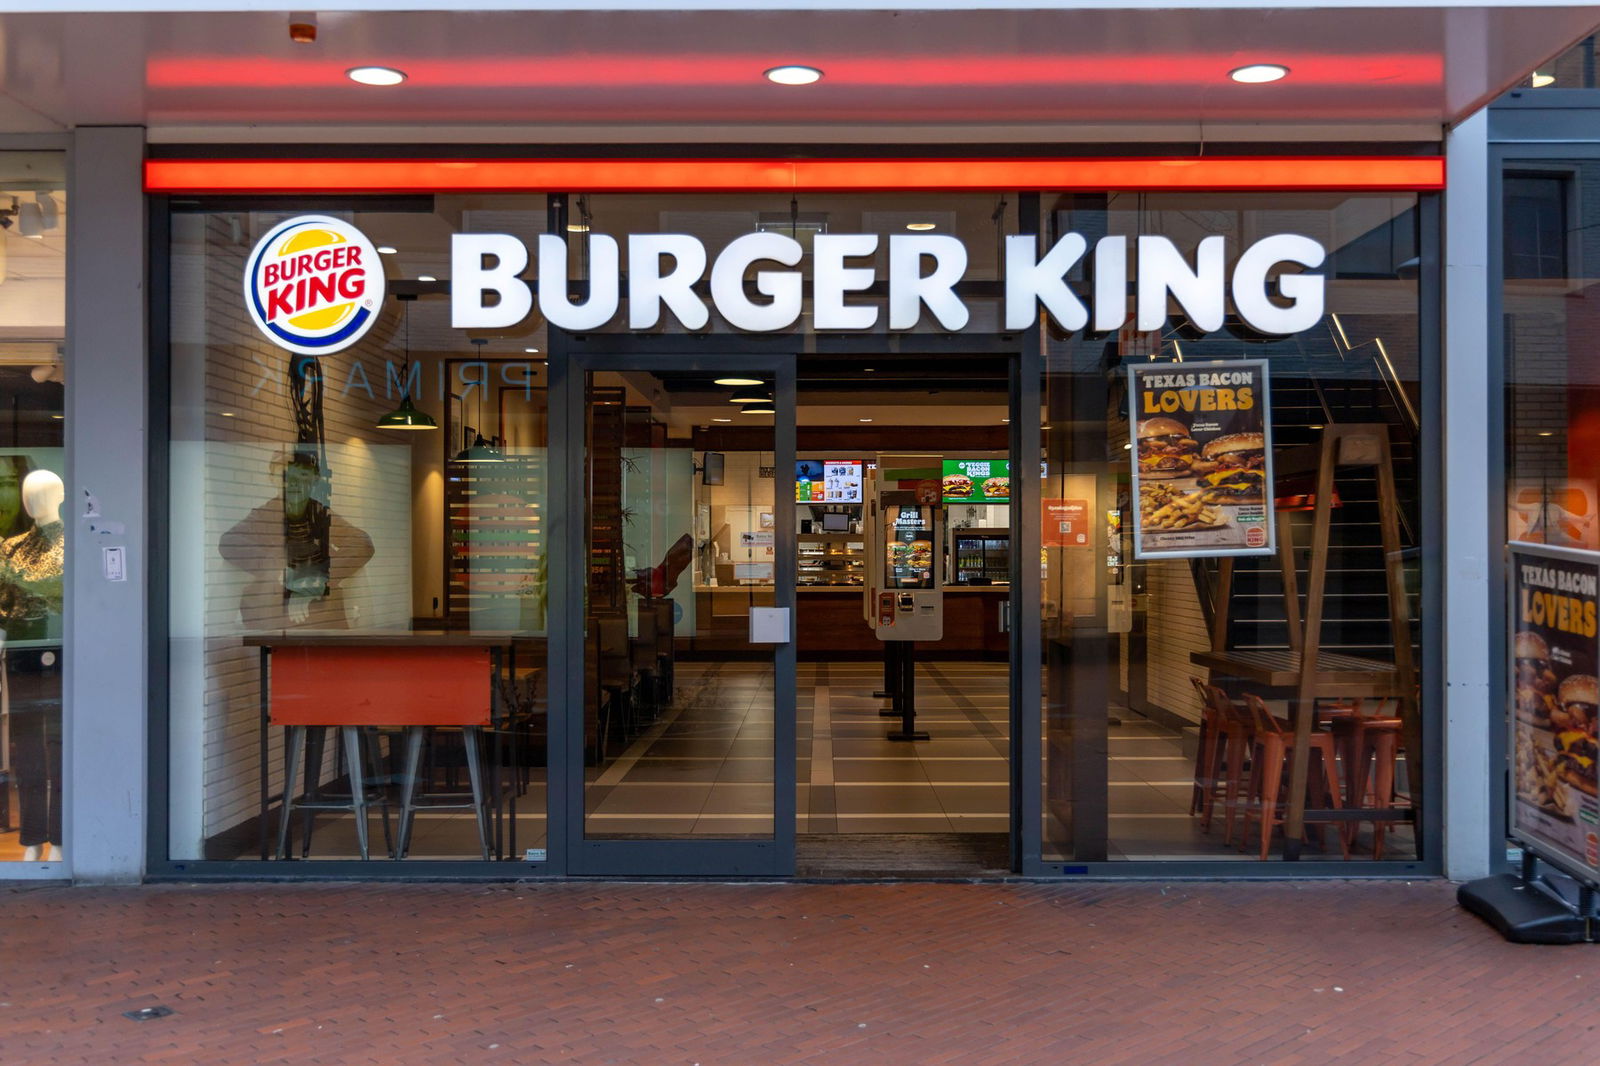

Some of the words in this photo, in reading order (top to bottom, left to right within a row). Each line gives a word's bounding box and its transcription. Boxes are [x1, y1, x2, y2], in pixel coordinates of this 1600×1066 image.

[264, 246, 362, 288] BURGER
[451, 231, 969, 332] BURGER
[1006, 231, 1326, 334] KING
[267, 268, 366, 321] KING
[1142, 373, 1196, 388] TEXAS
[1199, 371, 1253, 386] BACON
[1143, 387, 1254, 413] LOVERS
[892, 518, 925, 526] Masters
[900, 511, 918, 519] Grill
[1521, 564, 1556, 590] TEXAS
[1557, 569, 1597, 596] BACON
[1522, 588, 1597, 638] LOVERS
